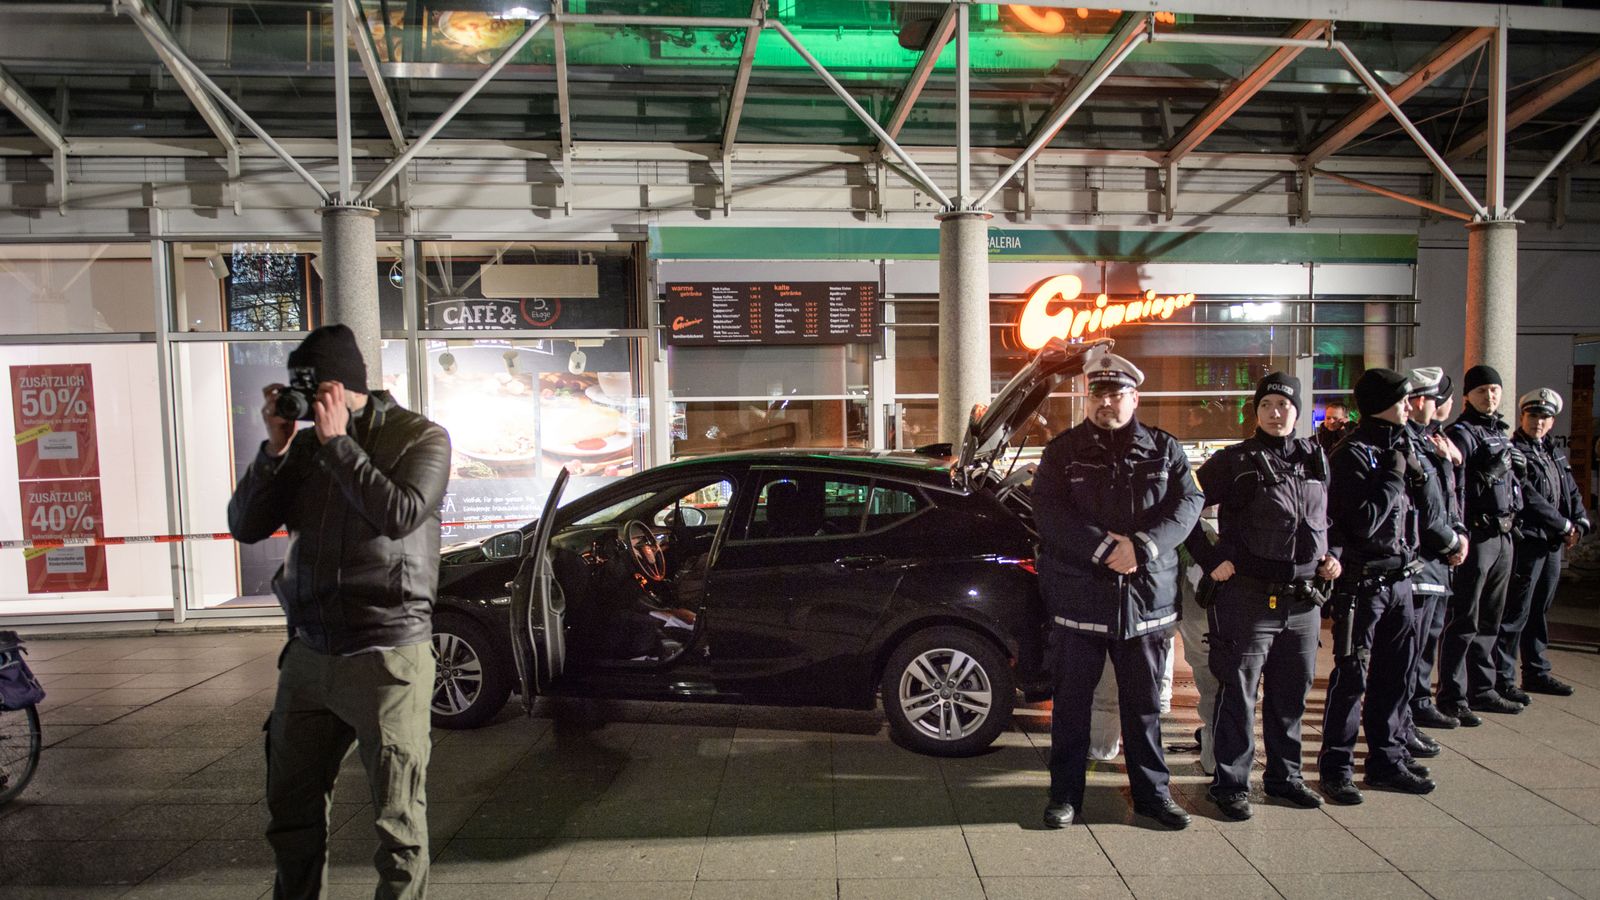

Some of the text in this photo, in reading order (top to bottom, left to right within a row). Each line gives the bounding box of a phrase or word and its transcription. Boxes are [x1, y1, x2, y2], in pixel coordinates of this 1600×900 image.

[987, 236, 1022, 249] ALERIA
[443, 302, 517, 325] CAFÉ &
[531, 310, 551, 321] Etage
[19, 375, 84, 388] ZUSÄTZLICH
[1267, 383, 1294, 396] POLIZEI
[21, 388, 87, 417] 50%
[29, 490, 93, 504] ZUSÄTZLICH
[31, 504, 94, 532] 40%
